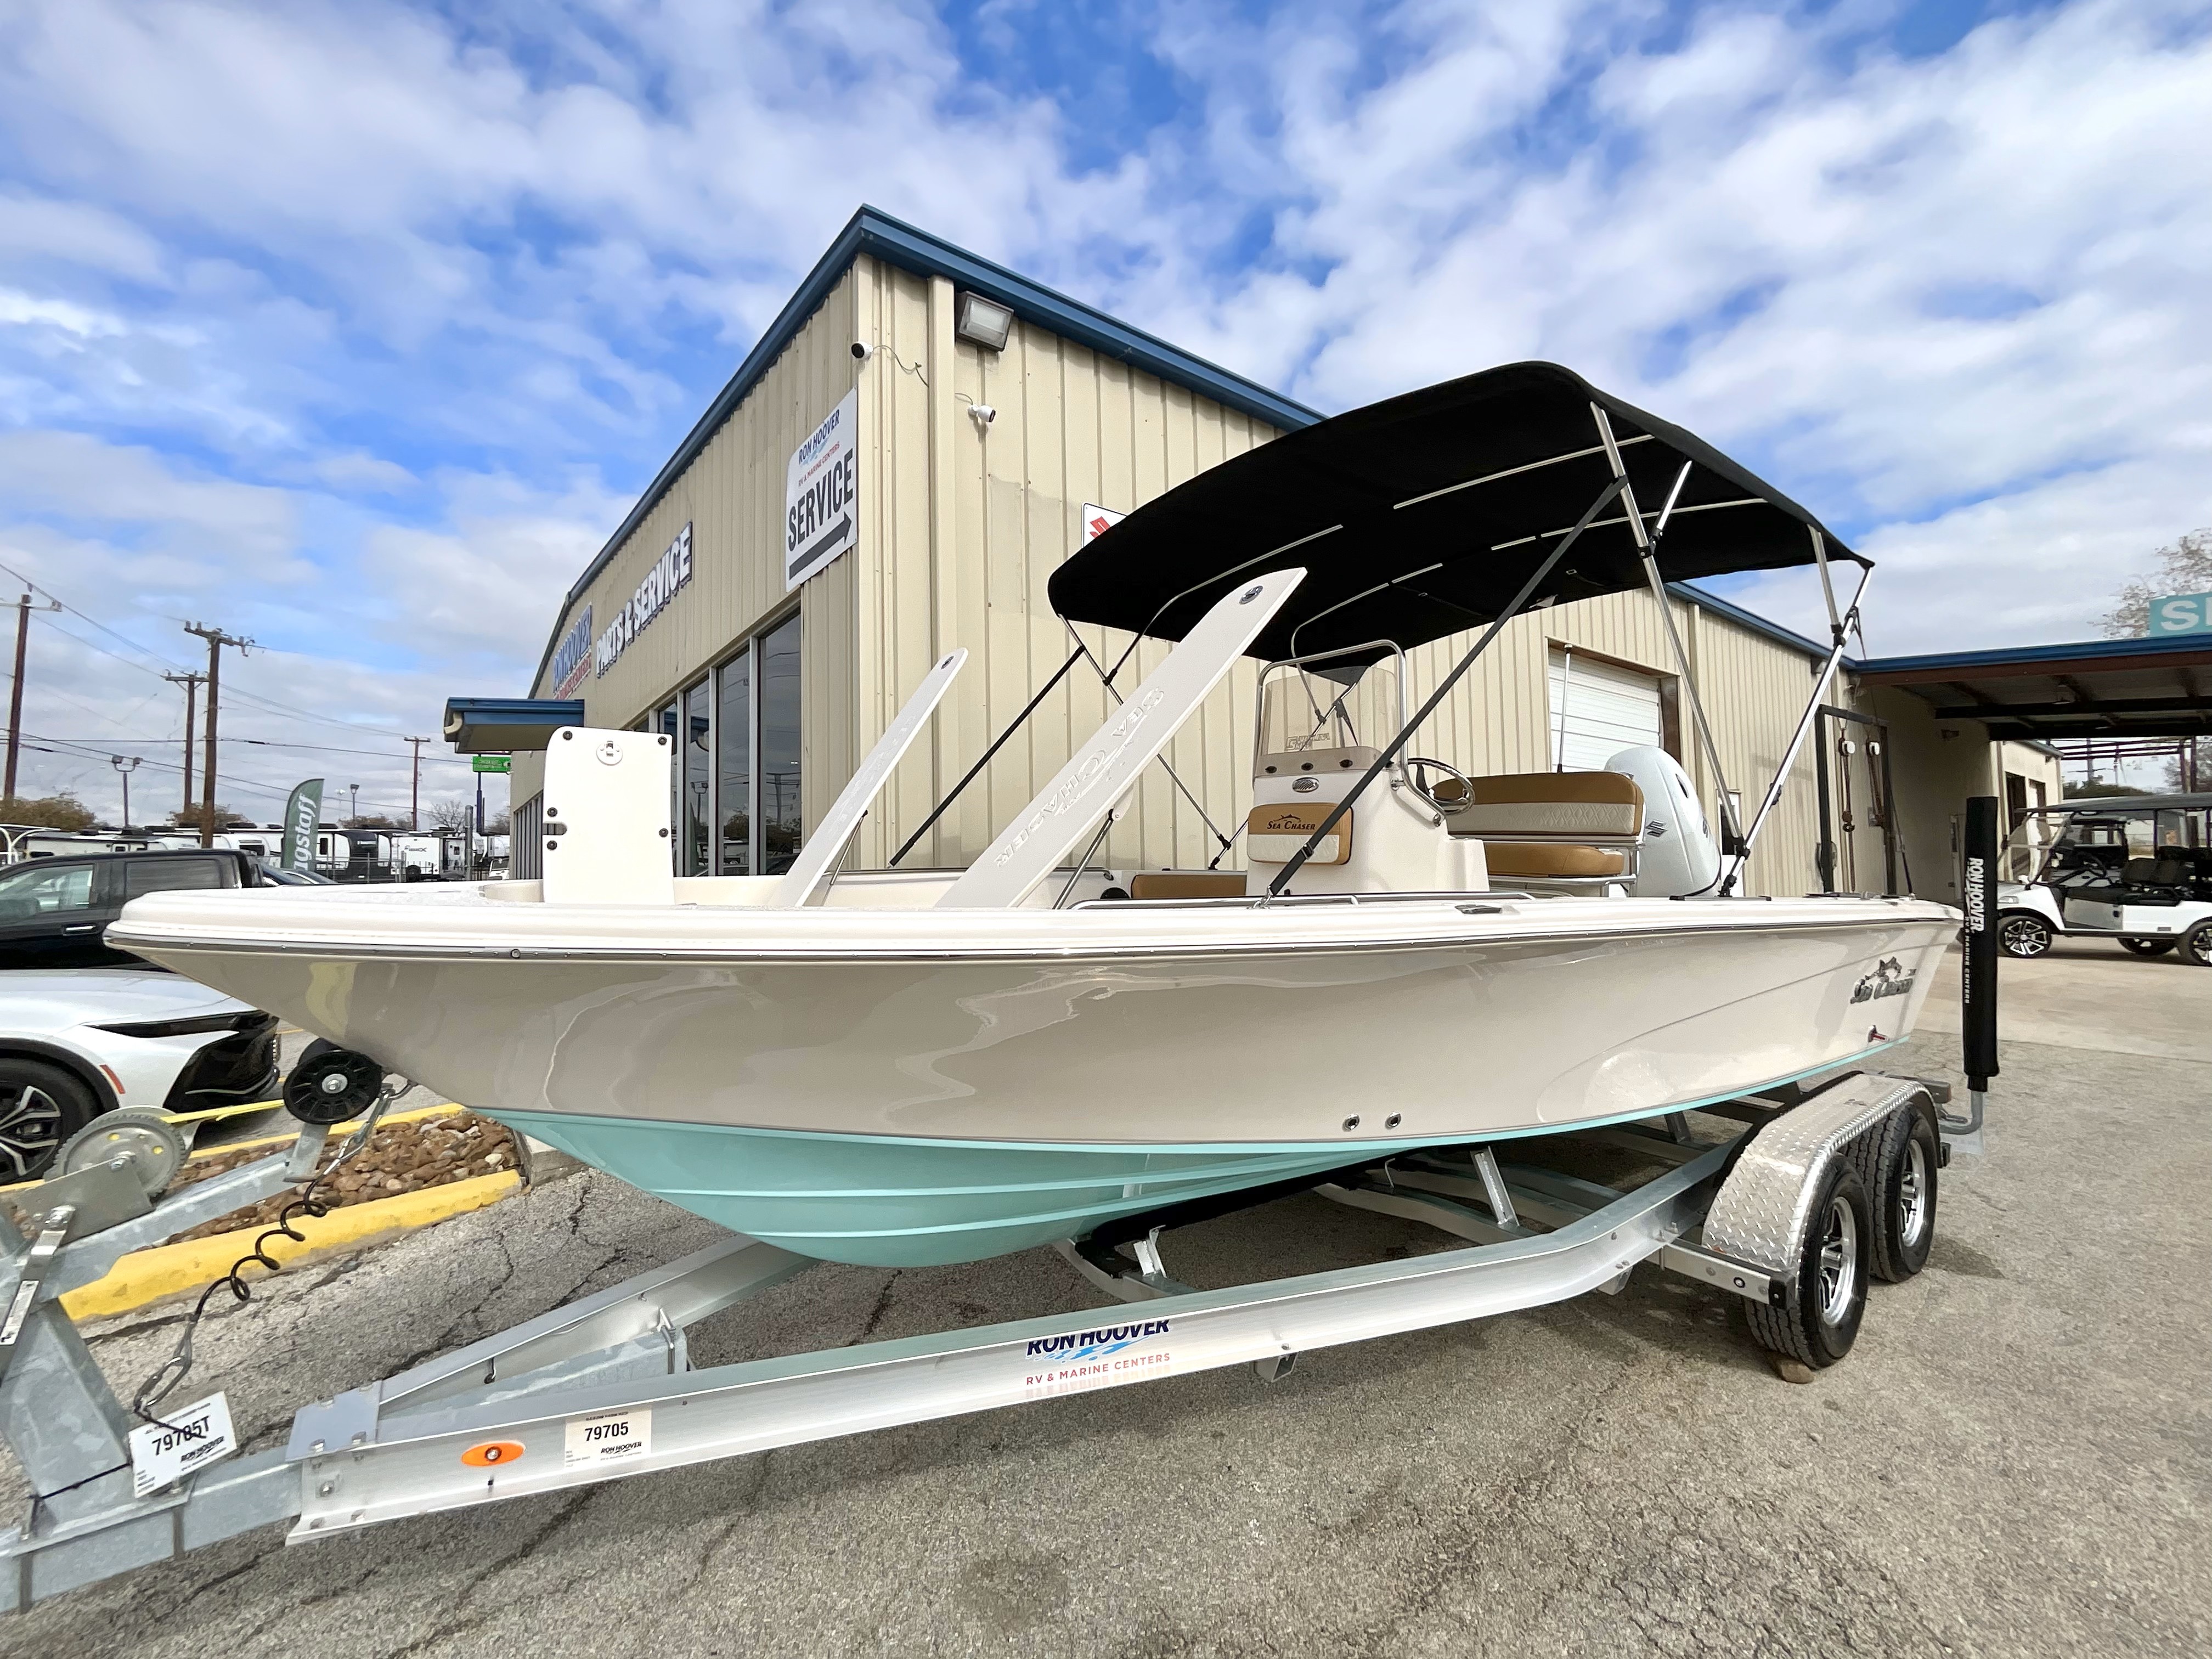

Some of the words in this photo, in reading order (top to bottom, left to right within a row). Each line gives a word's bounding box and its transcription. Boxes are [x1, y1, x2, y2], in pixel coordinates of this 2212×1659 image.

[799, 439, 812, 465] RON
[813, 409, 840, 450] HOOVER
[822, 442, 840, 464] CENTERS
[788, 448, 853, 552] SERVICE
[596, 610, 625, 678] PARTS
[625, 599, 634, 646] &
[634, 522, 692, 635] SERVICE
[1968, 857, 1984, 883] RON
[1970, 884, 1985, 933] HOOVER
[1026, 1334, 1075, 1356] RON
[1079, 1319, 1170, 1347] HOOVER
[1026, 1375, 1042, 1385] RV
[1047, 1373, 1054, 1381] &
[1059, 1363, 1109, 1379] MARINE
[1114, 1353, 1170, 1369] CENTERS
[585, 1421, 629, 1442] 79705
[616, 1441, 642, 1452] HOOVER
